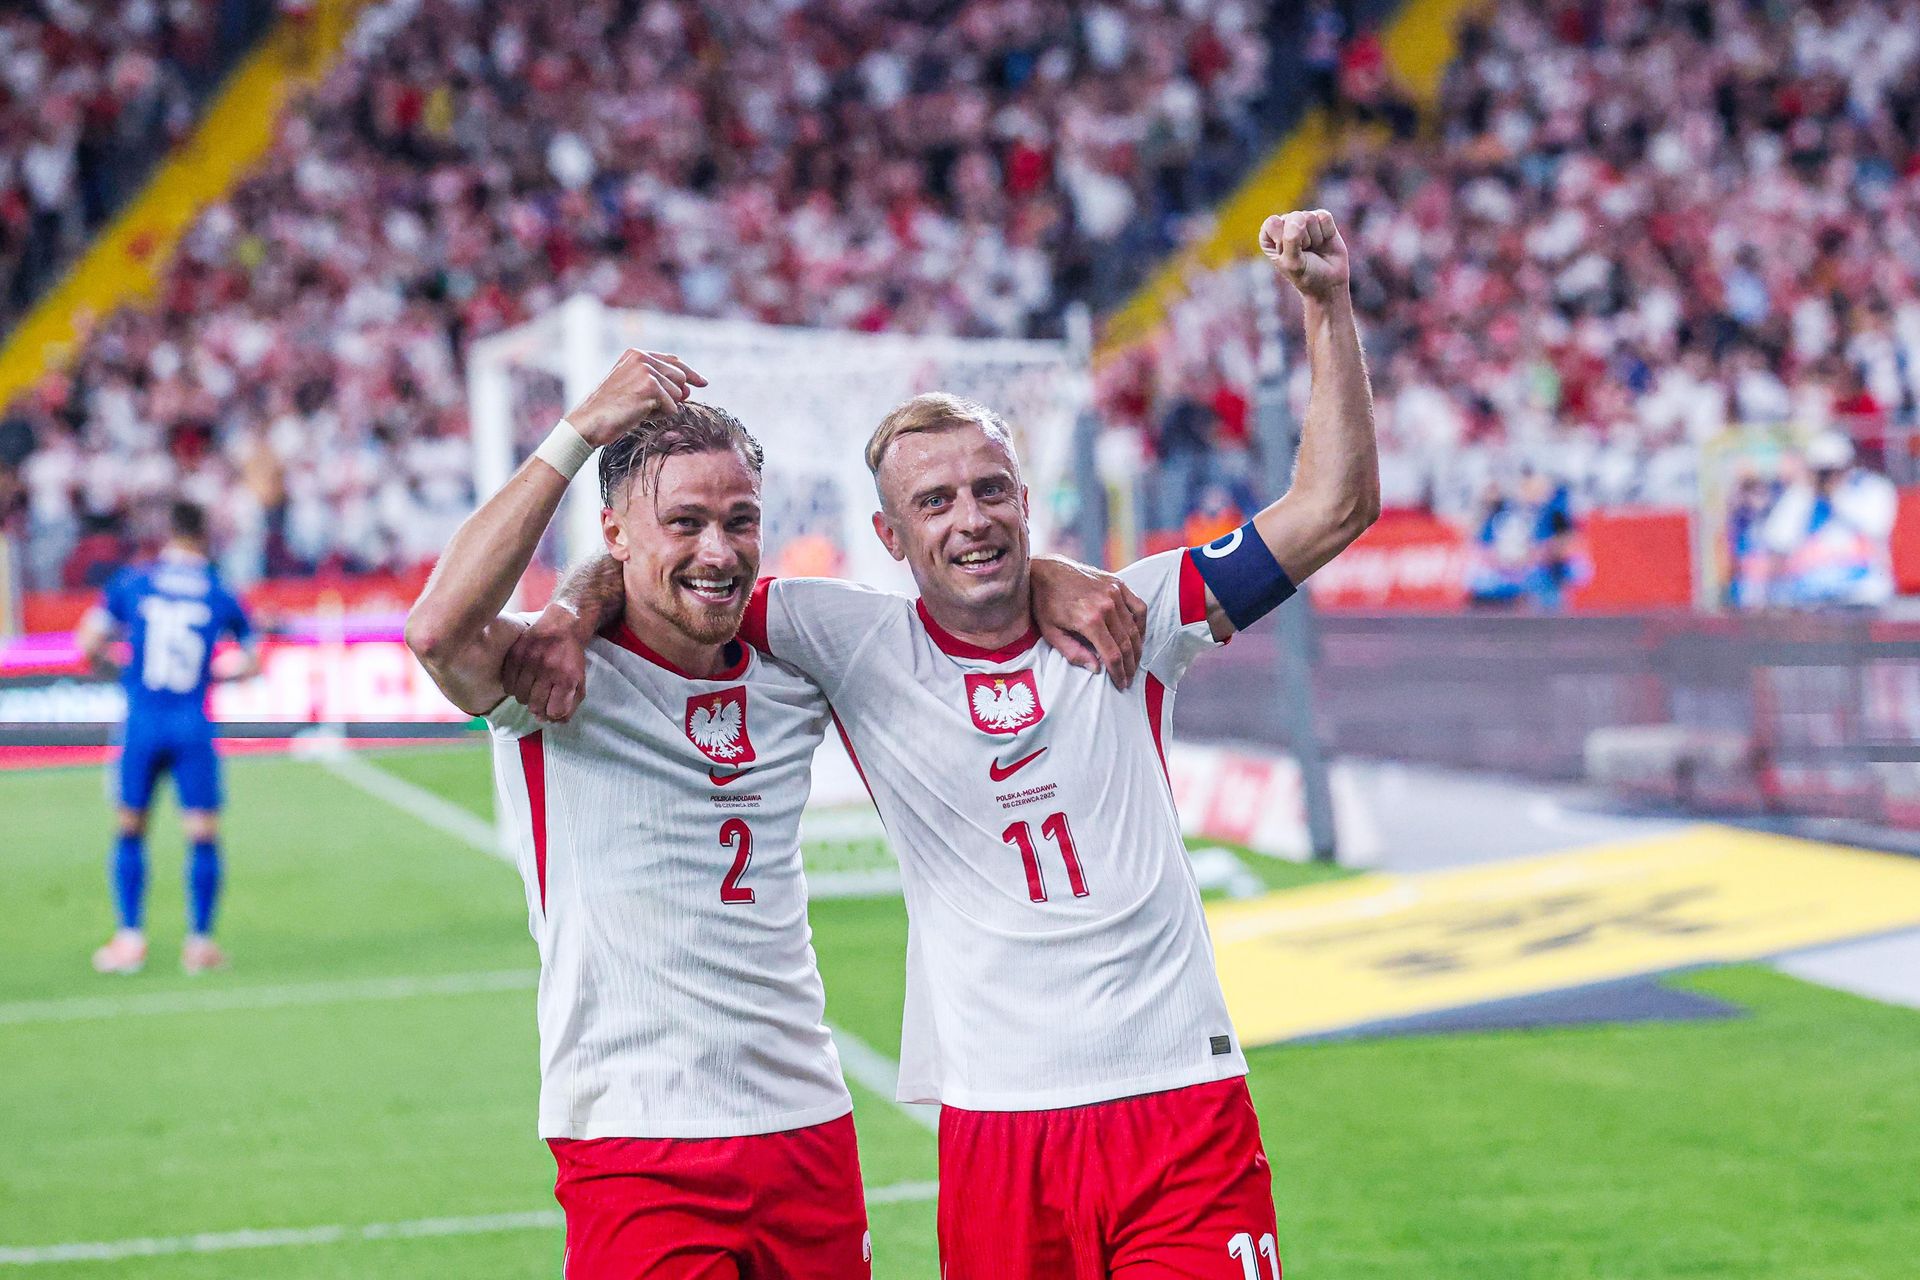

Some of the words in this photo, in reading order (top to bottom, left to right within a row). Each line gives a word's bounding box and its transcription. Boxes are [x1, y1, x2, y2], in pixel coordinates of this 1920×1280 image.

[138, 595, 213, 693] 15
[995, 782, 1058, 803] POLSKA-MOŁDAWIA
[1010, 795, 1040, 808] CZERWCA
[1039, 790, 1056, 800] 2025
[719, 817, 756, 905] 2
[1001, 811, 1091, 904] 11
[1227, 1233, 1280, 1280] 11
